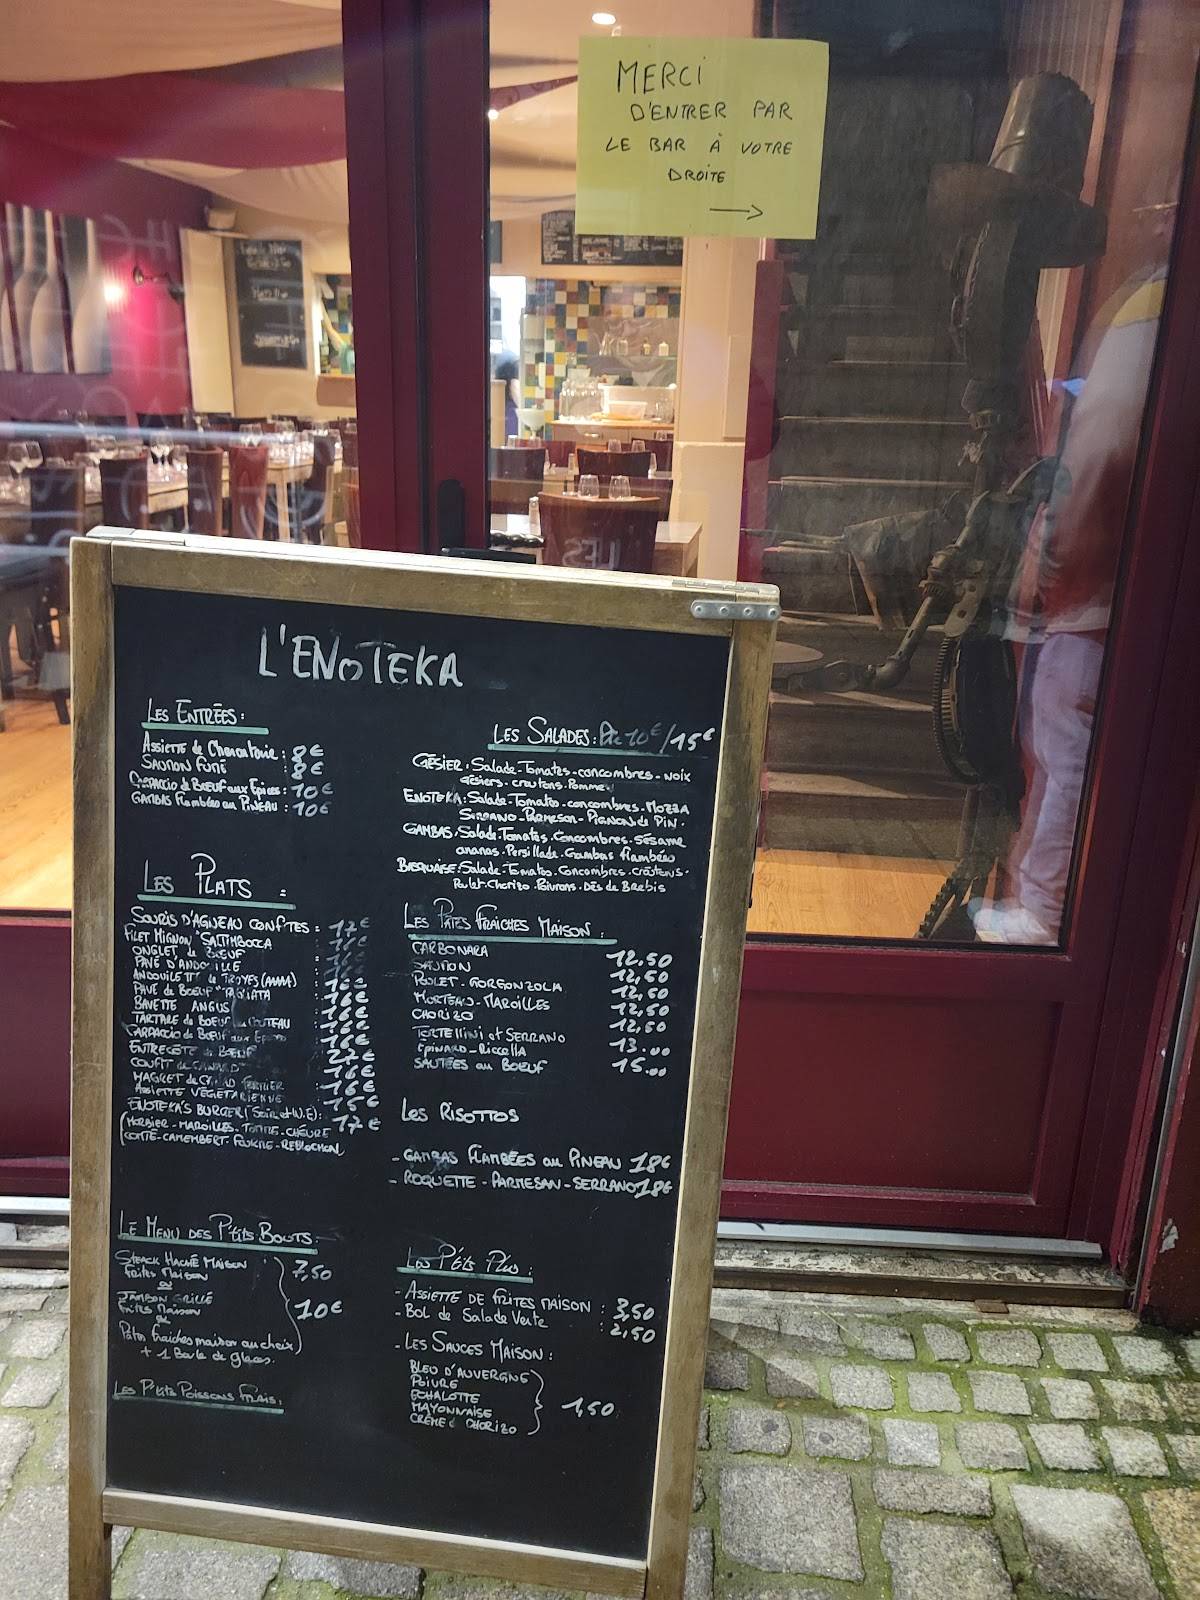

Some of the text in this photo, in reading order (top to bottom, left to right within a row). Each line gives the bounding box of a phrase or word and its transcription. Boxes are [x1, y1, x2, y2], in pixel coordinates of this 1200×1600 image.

[630, 100, 793, 121] D'ENTRER PAR
[605, 137, 631, 152] LE
[649, 137, 686, 152] BAR
[741, 141, 793, 155] VOTRE
[493, 723, 520, 744] LES
[455, 845, 500, 856] ananas
[144, 853, 252, 898] LES PLATS
[606, 879, 619, 892] de
[181, 909, 243, 930] D'AGNEAU
[404, 902, 430, 929] LES
[132, 945, 178, 957] ONGLET
[412, 941, 489, 957] CARBONARA
[469, 976, 563, 993] GORGONZOLA
[134, 995, 369, 1021] BAVETTE ANGUS 16€
[320, 1033, 370, 1049] 16€
[505, 1027, 566, 1043] SERRANO
[323, 1064, 376, 1080] 16€
[133, 1071, 184, 1084] MAGRET
[320, 1079, 376, 1096] 16€
[332, 1114, 382, 1135] 17€
[163, 1132, 229, 1146] CAMEMBERT
[403, 1169, 477, 1189] ROQUETTE
[491, 1170, 561, 1190] PARMESAN
[574, 1176, 635, 1194] SERRANO
[146, 1215, 180, 1239] MENU
[188, 1228, 212, 1240] DES
[294, 1298, 343, 1320] 10€
[468, 1293, 485, 1306] DE
[438, 1304, 451, 1322] de
[462, 1307, 508, 1325] Salade
[404, 1331, 428, 1351] LES
[431, 1330, 483, 1356] SAUCES
[444, 1363, 530, 1383] D'AUVERGNE
[410, 1389, 481, 1404] ECHALOTTE
